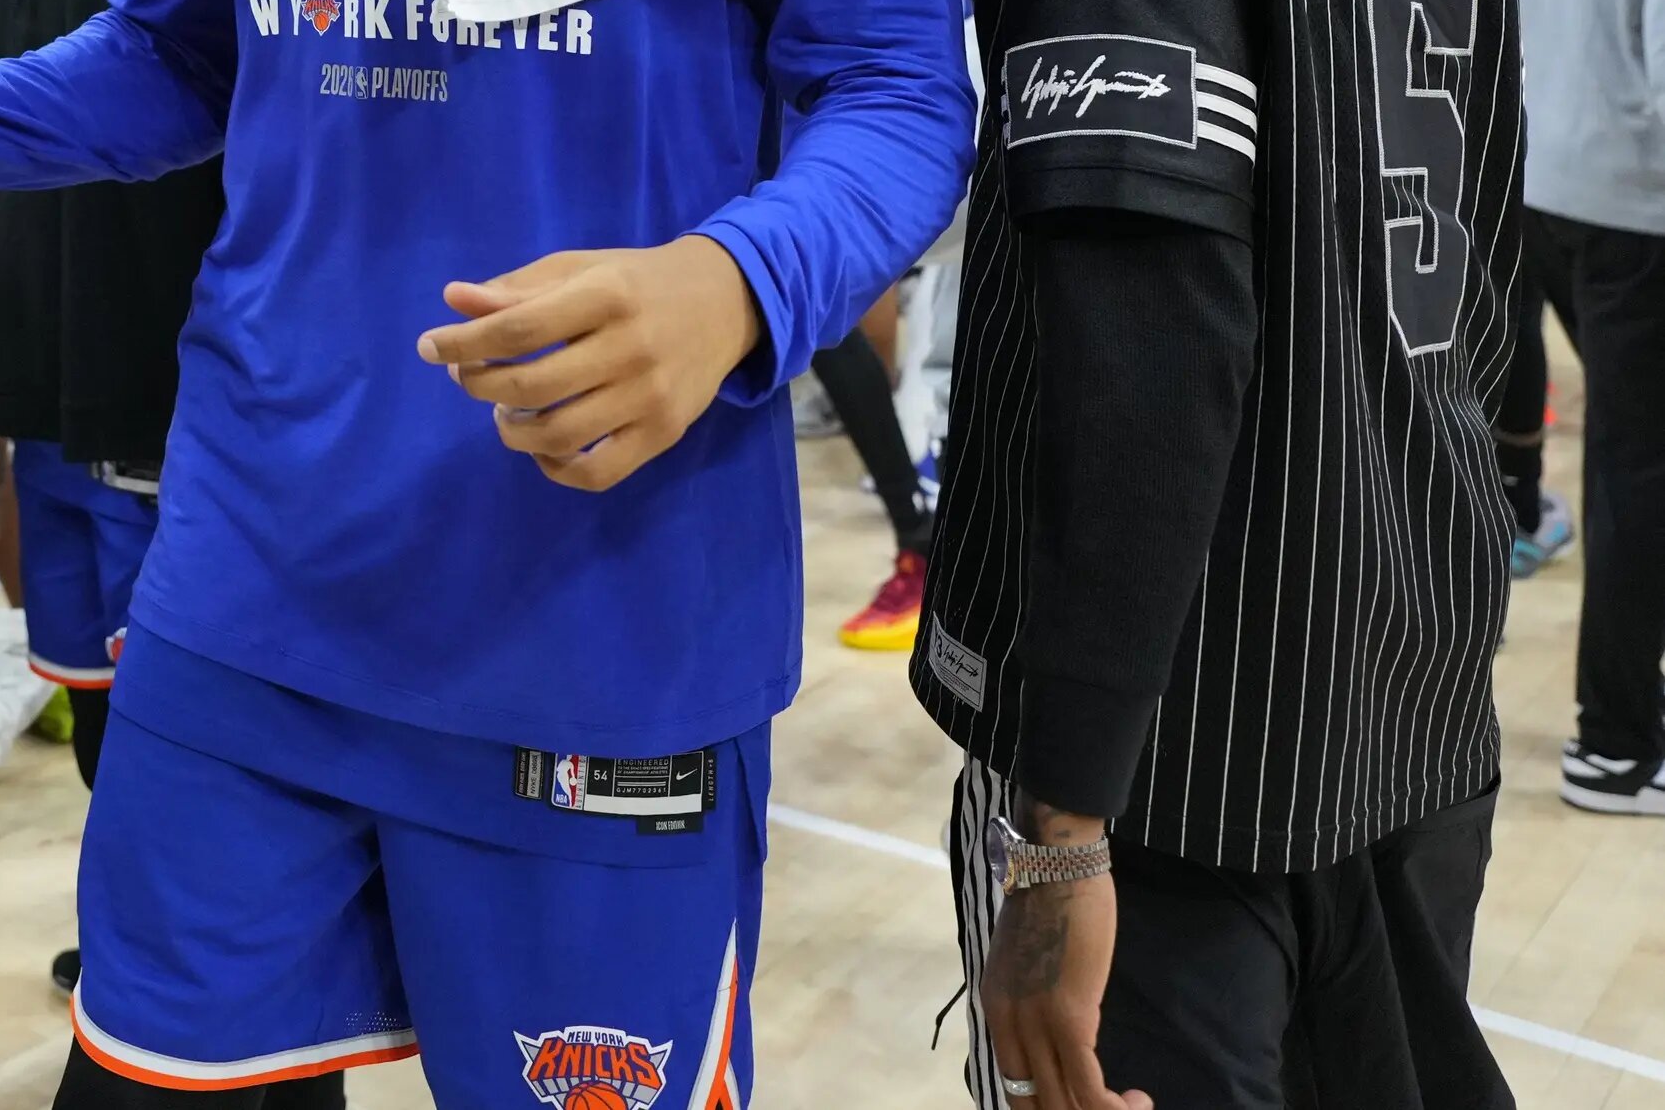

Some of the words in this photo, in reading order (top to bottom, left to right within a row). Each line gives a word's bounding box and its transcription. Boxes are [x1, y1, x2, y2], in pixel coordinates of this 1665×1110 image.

[371, 67, 448, 103] PLAYOFFS
[617, 758, 669, 766] ENGINEERED
[593, 769, 608, 781] 54
[555, 793, 568, 804] NBA
[566, 1030, 591, 1043] NEW
[595, 1031, 624, 1047] YORK
[528, 1038, 662, 1090] KNICKS
